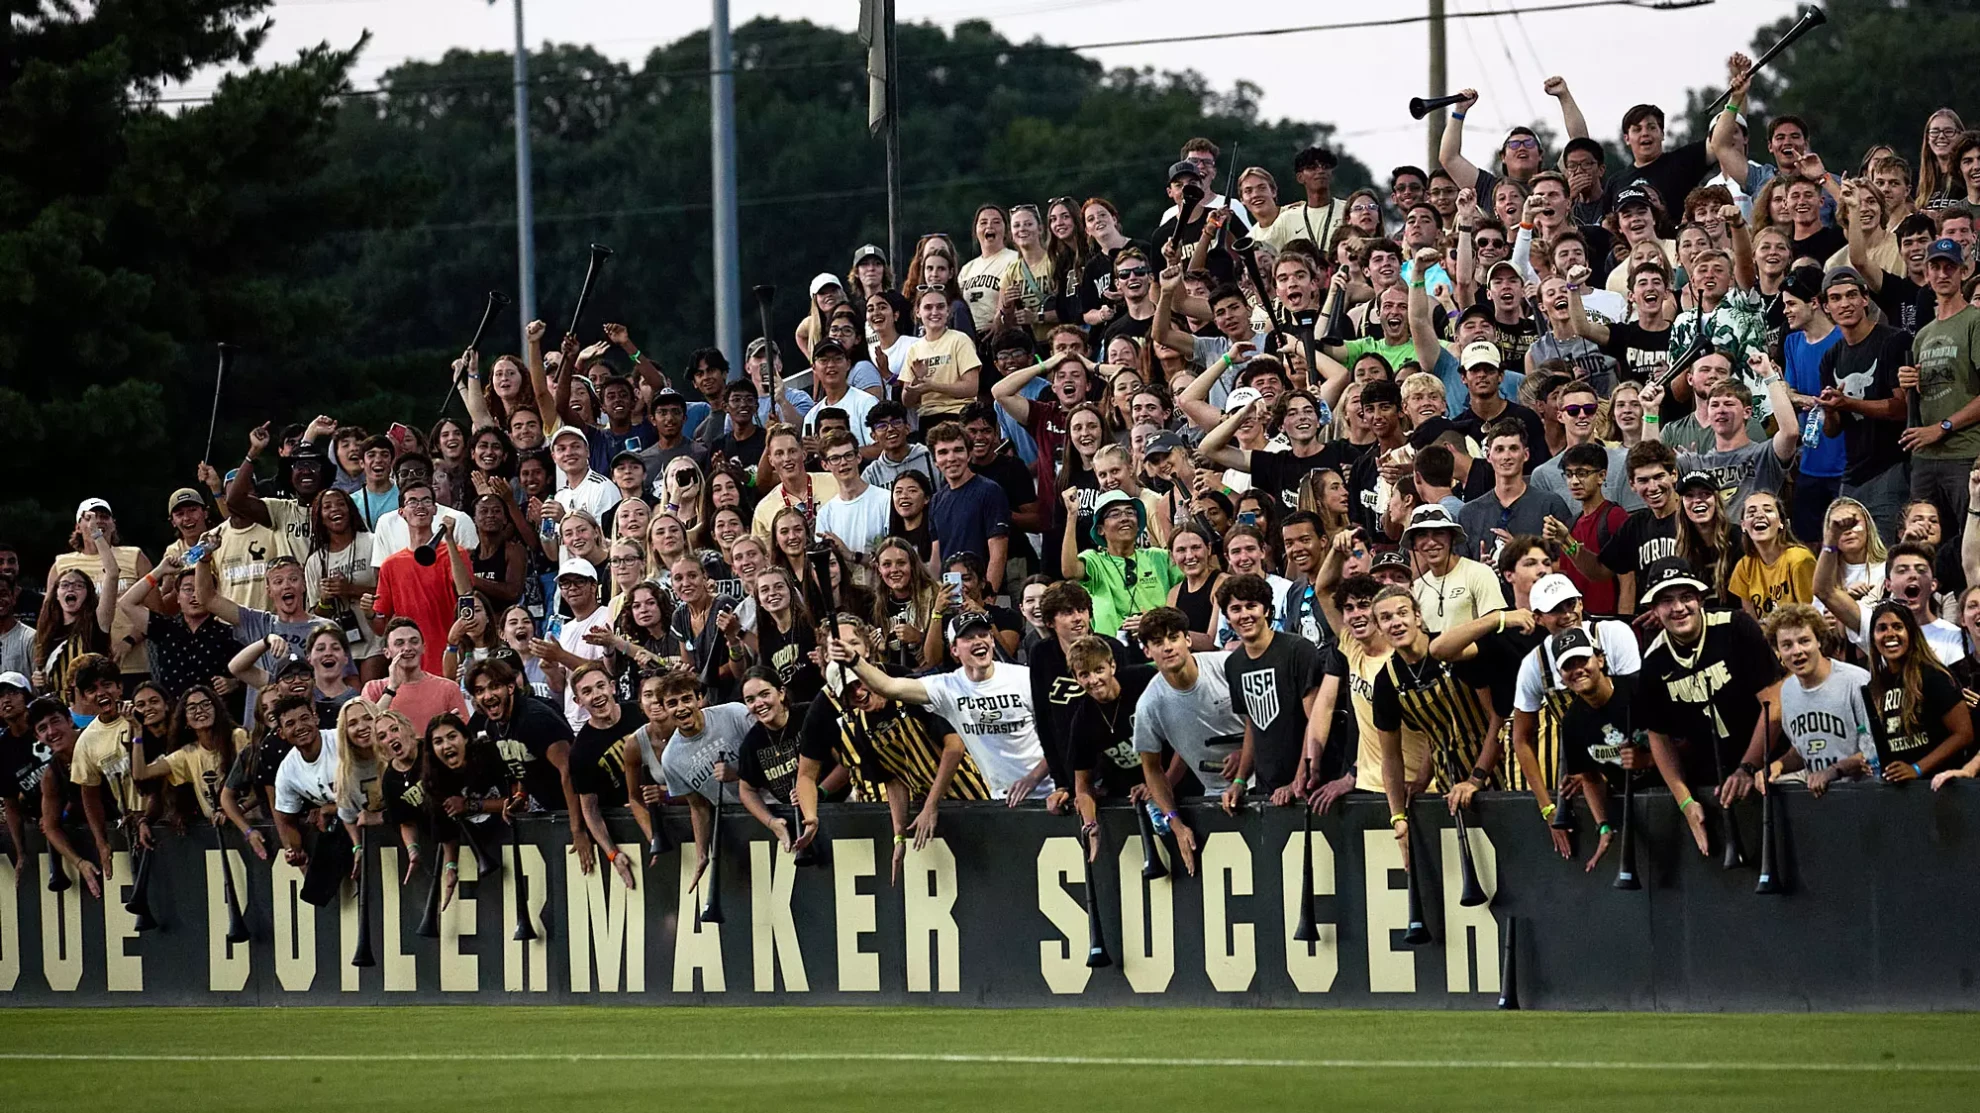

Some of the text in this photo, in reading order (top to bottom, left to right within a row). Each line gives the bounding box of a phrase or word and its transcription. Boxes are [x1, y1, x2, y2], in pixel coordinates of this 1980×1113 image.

[1048, 676, 1088, 705] P
[1243, 671, 1274, 696] USA
[957, 693, 1023, 712] PURDUE
[979, 711, 1003, 724] P
[1790, 711, 1847, 739] PROUD
[1806, 739, 1827, 755] P
[764, 757, 799, 781] BOILER
[205, 837, 960, 993] BOILERMAKER
[1037, 827, 1500, 994] SOCCER
